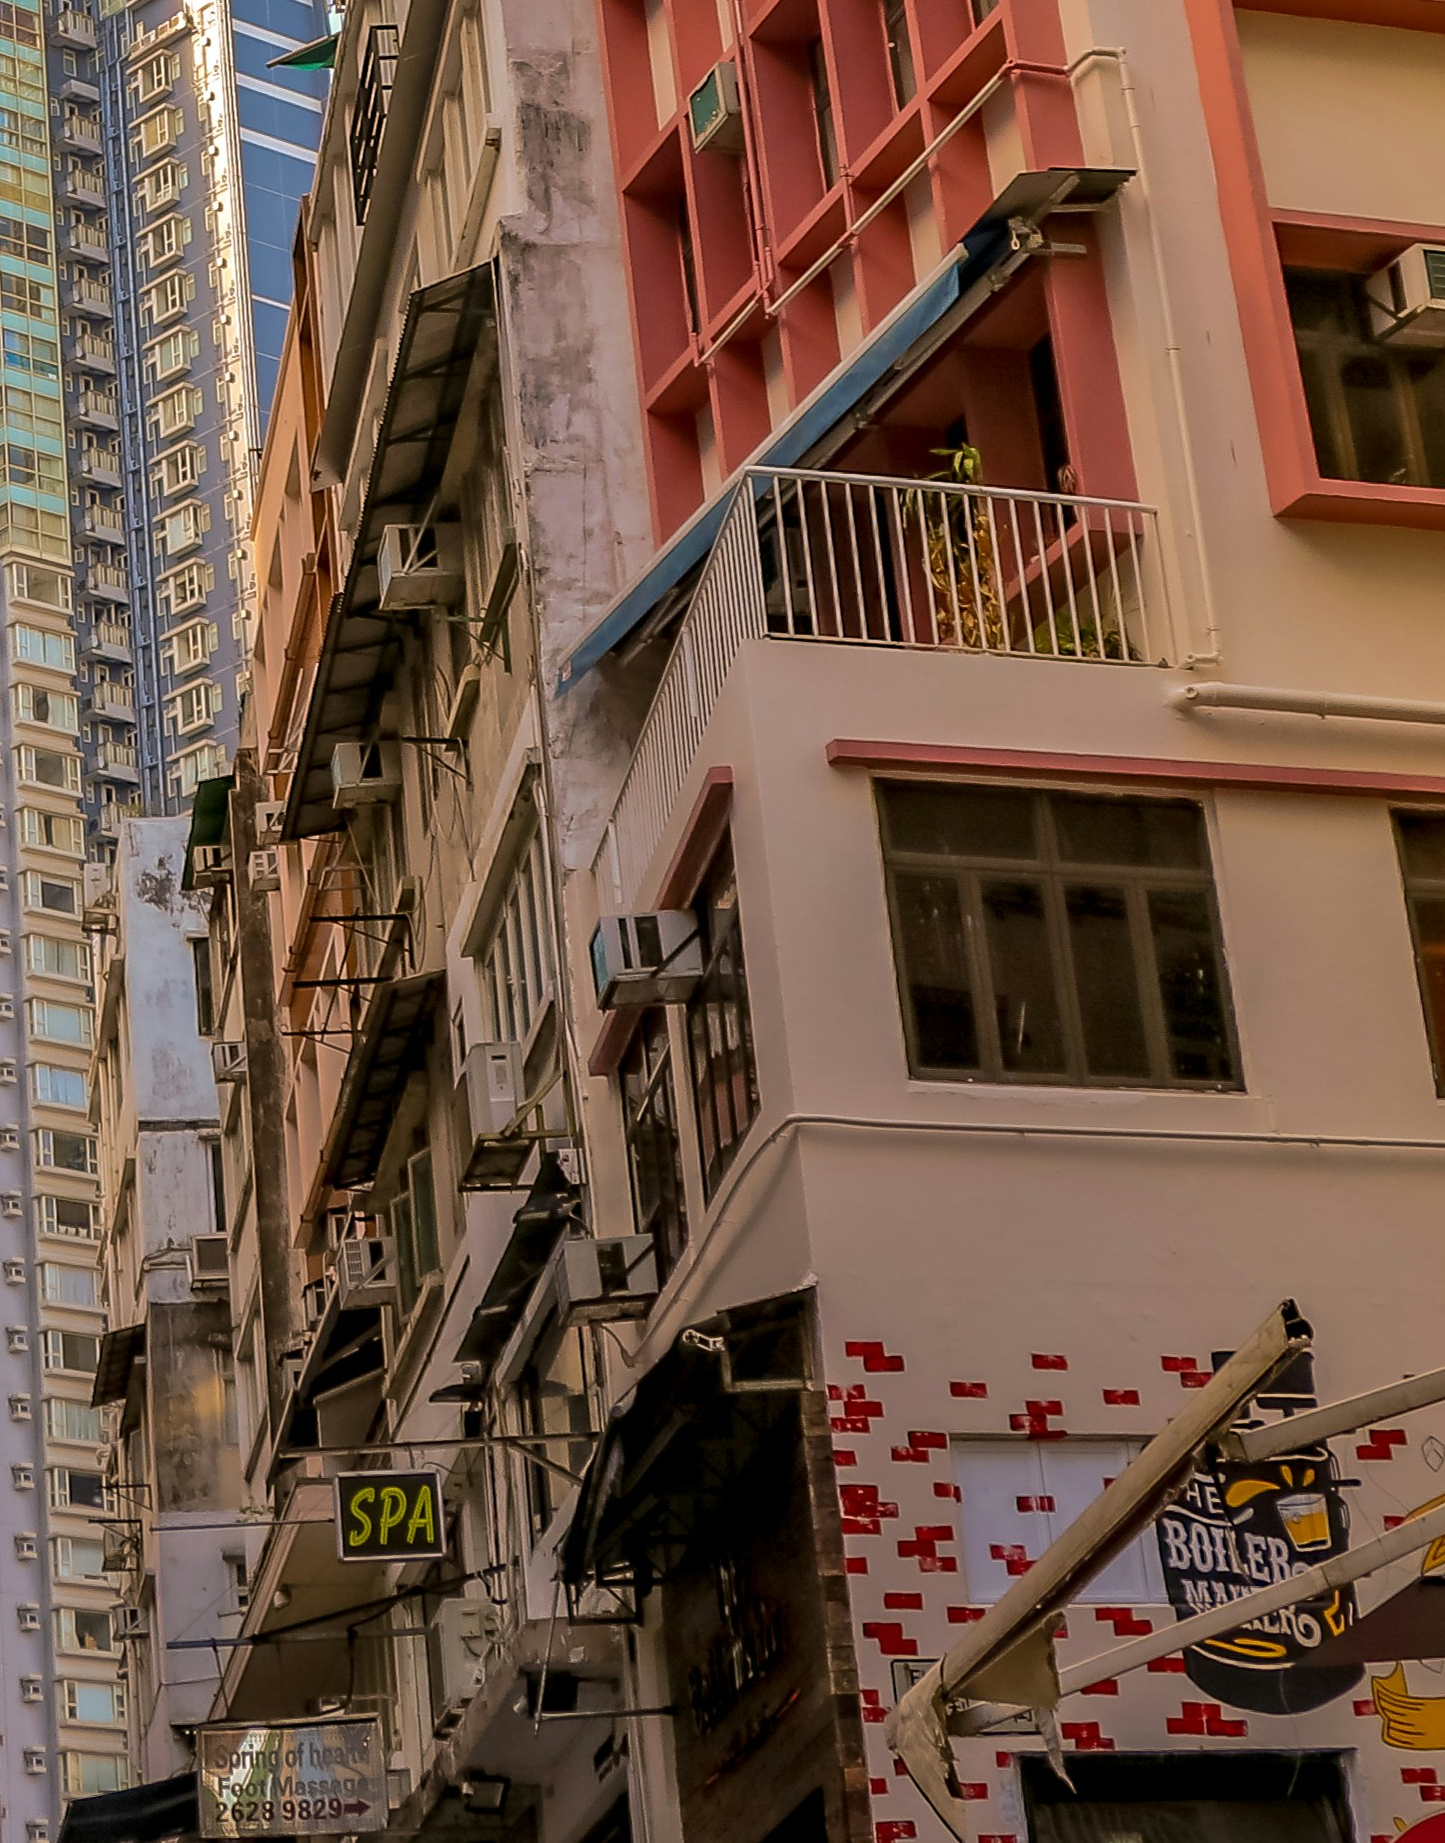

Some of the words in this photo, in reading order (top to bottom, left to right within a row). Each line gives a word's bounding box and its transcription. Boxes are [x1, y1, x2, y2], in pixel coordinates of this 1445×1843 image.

[1185, 1481, 1225, 1515] HE
[348, 1484, 436, 1547] SPA
[1162, 1517, 1312, 1586] BOILER
[214, 1742, 280, 1774] Spring
[285, 1742, 306, 1768] of
[217, 1776, 268, 1799] Foot
[215, 1800, 275, 1823] 2628
[282, 1798, 343, 1821] 9829
